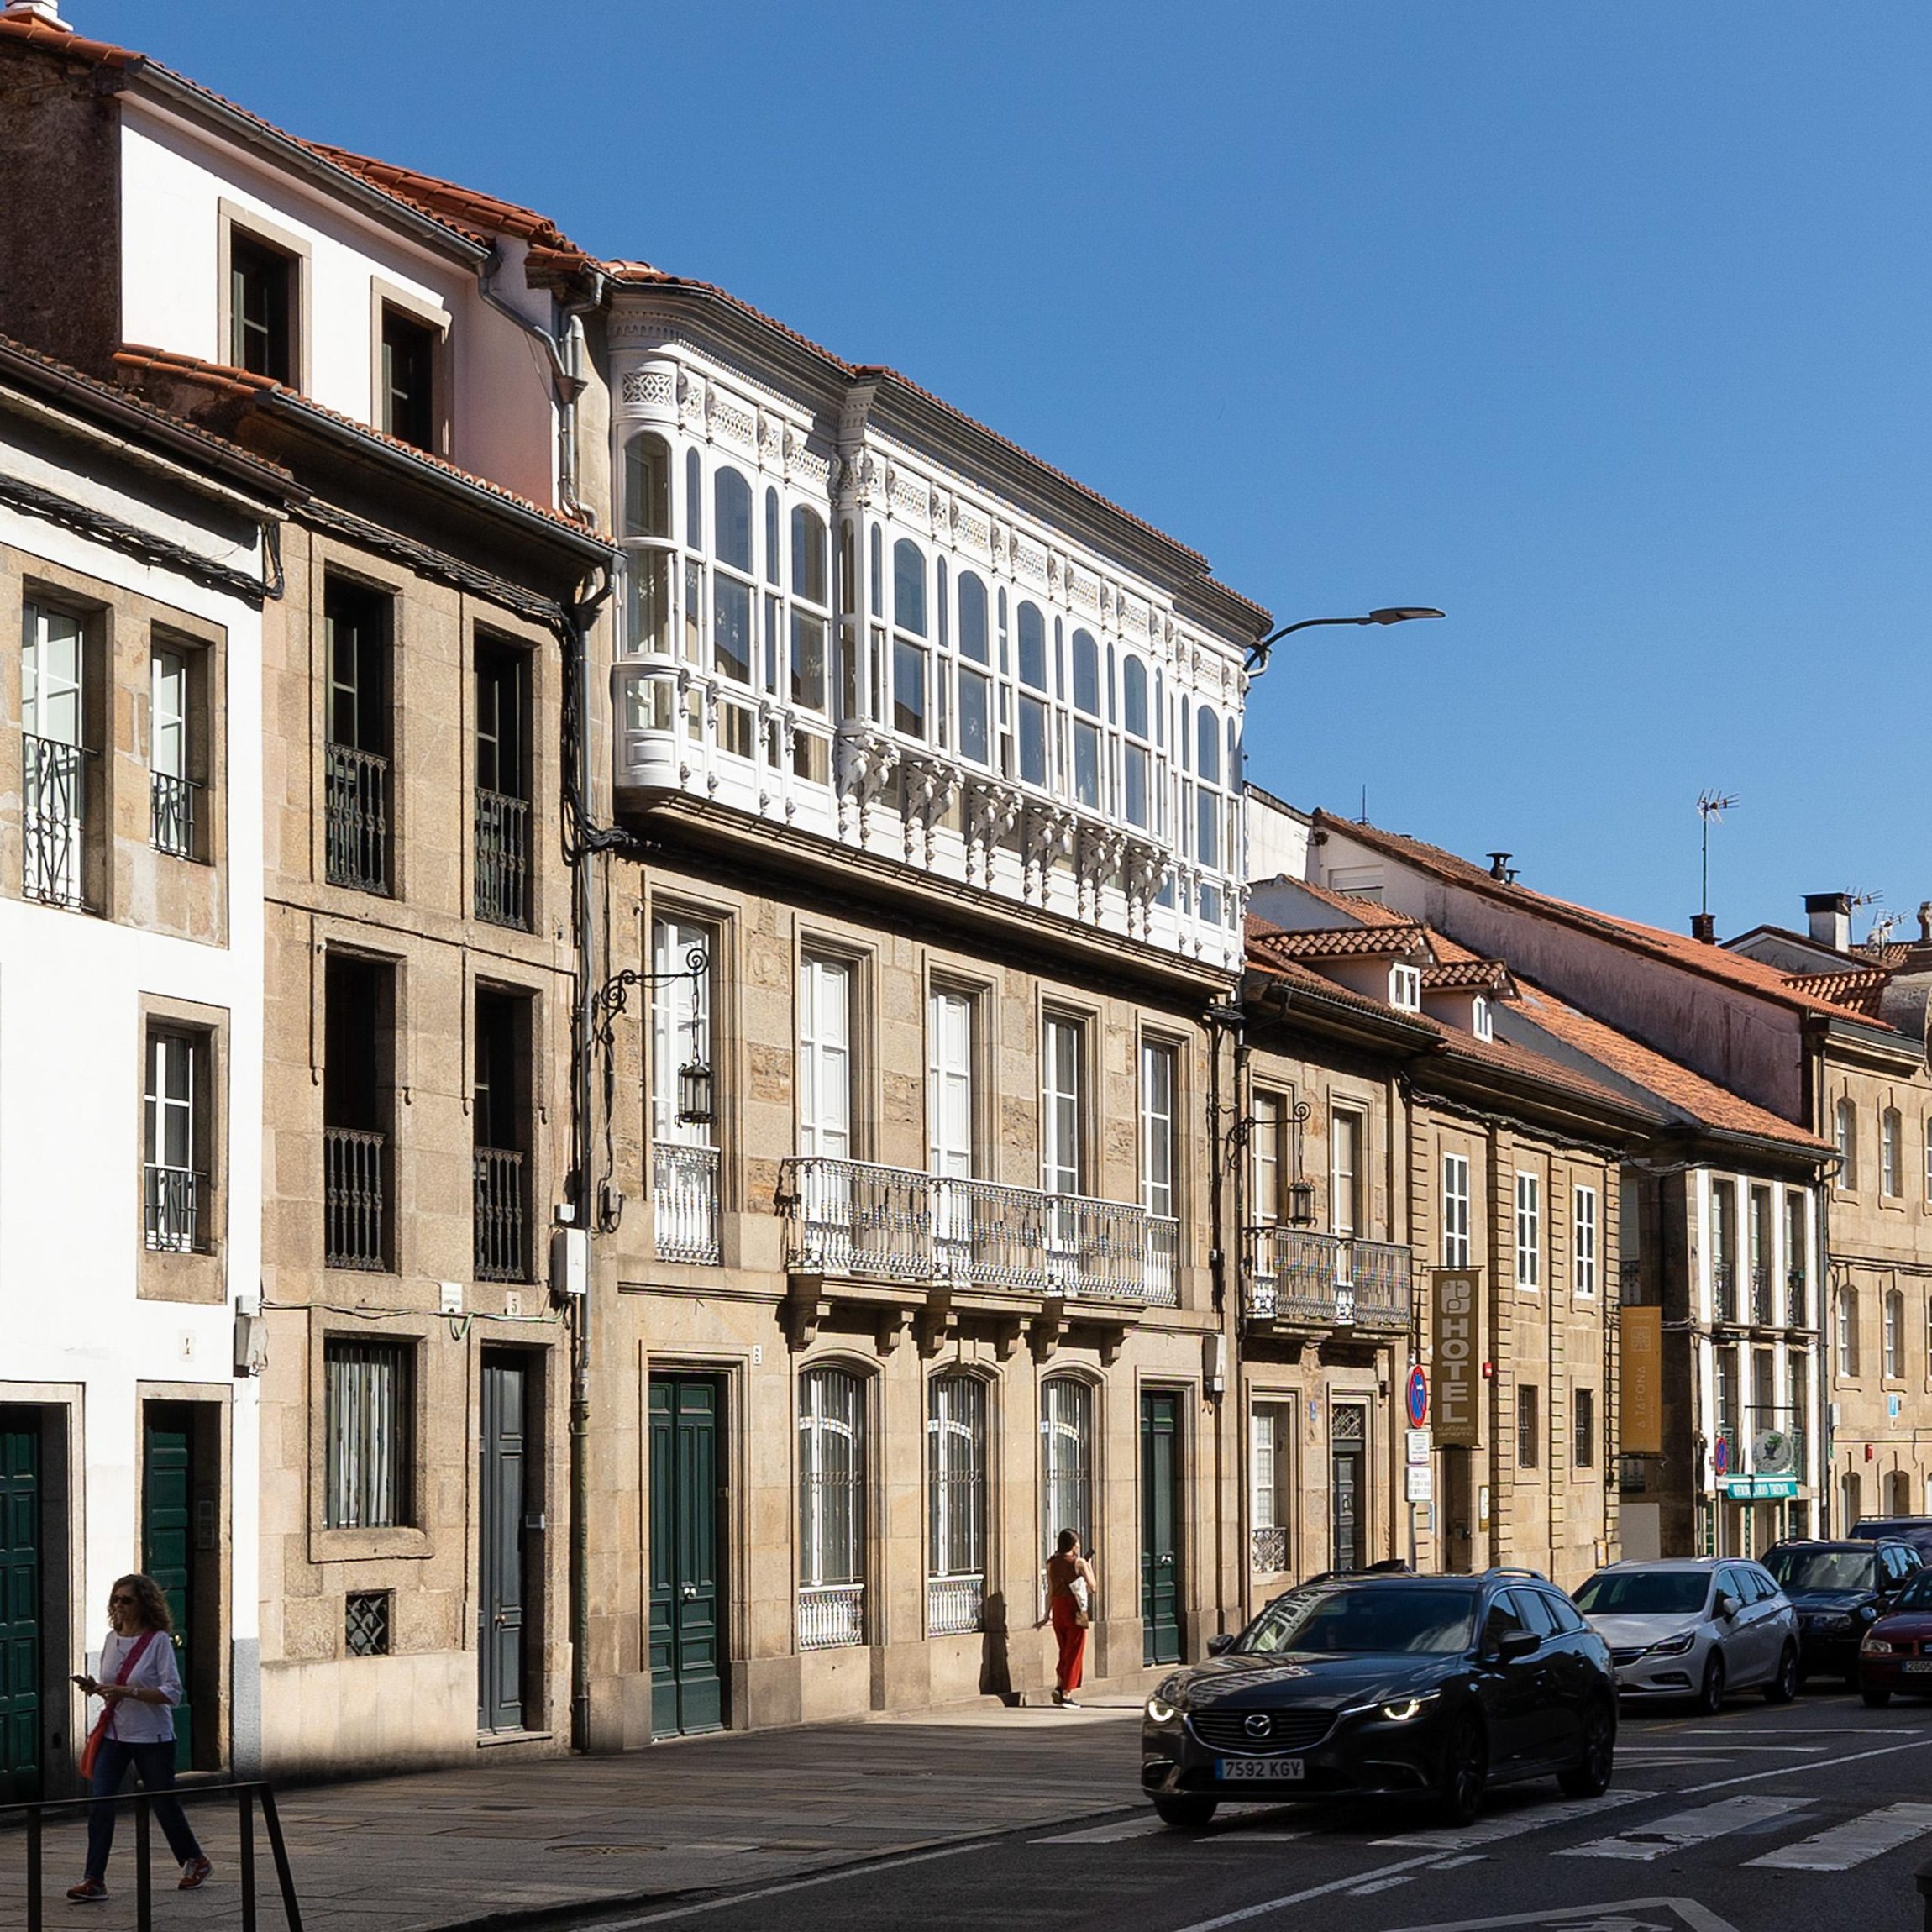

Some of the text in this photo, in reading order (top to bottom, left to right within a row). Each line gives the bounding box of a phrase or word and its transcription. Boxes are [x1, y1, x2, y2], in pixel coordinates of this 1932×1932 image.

[1441, 1317, 1470, 1424] HOTEL
[1226, 1761, 1300, 1777] 7592 KGV
